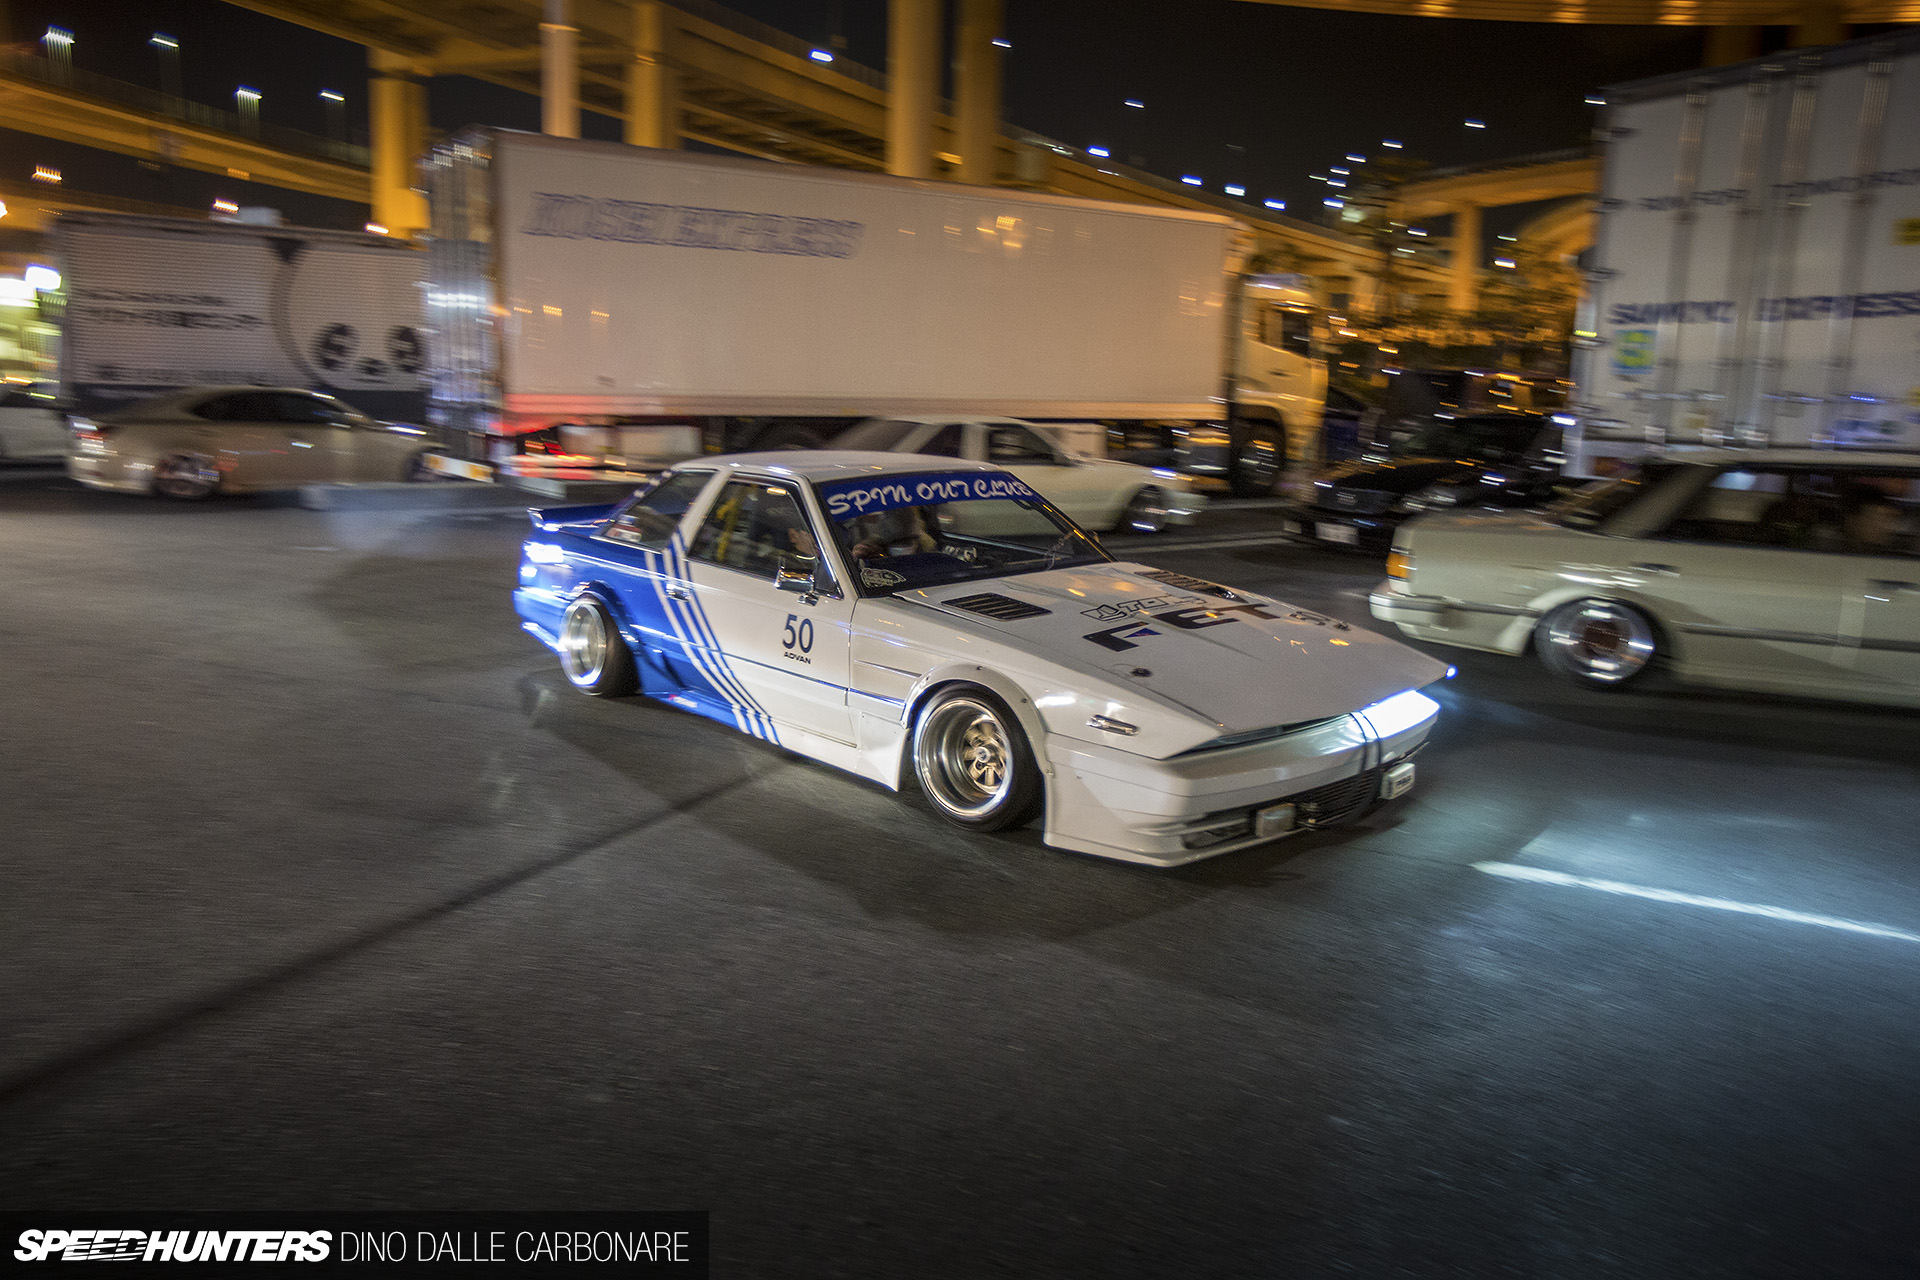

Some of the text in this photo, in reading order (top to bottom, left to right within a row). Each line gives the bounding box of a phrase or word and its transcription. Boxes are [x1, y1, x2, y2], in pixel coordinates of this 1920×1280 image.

[827, 479, 1033, 515] SPIN OUT CLUB
[782, 613, 814, 654] 50
[784, 651, 811, 664] ADVAN
